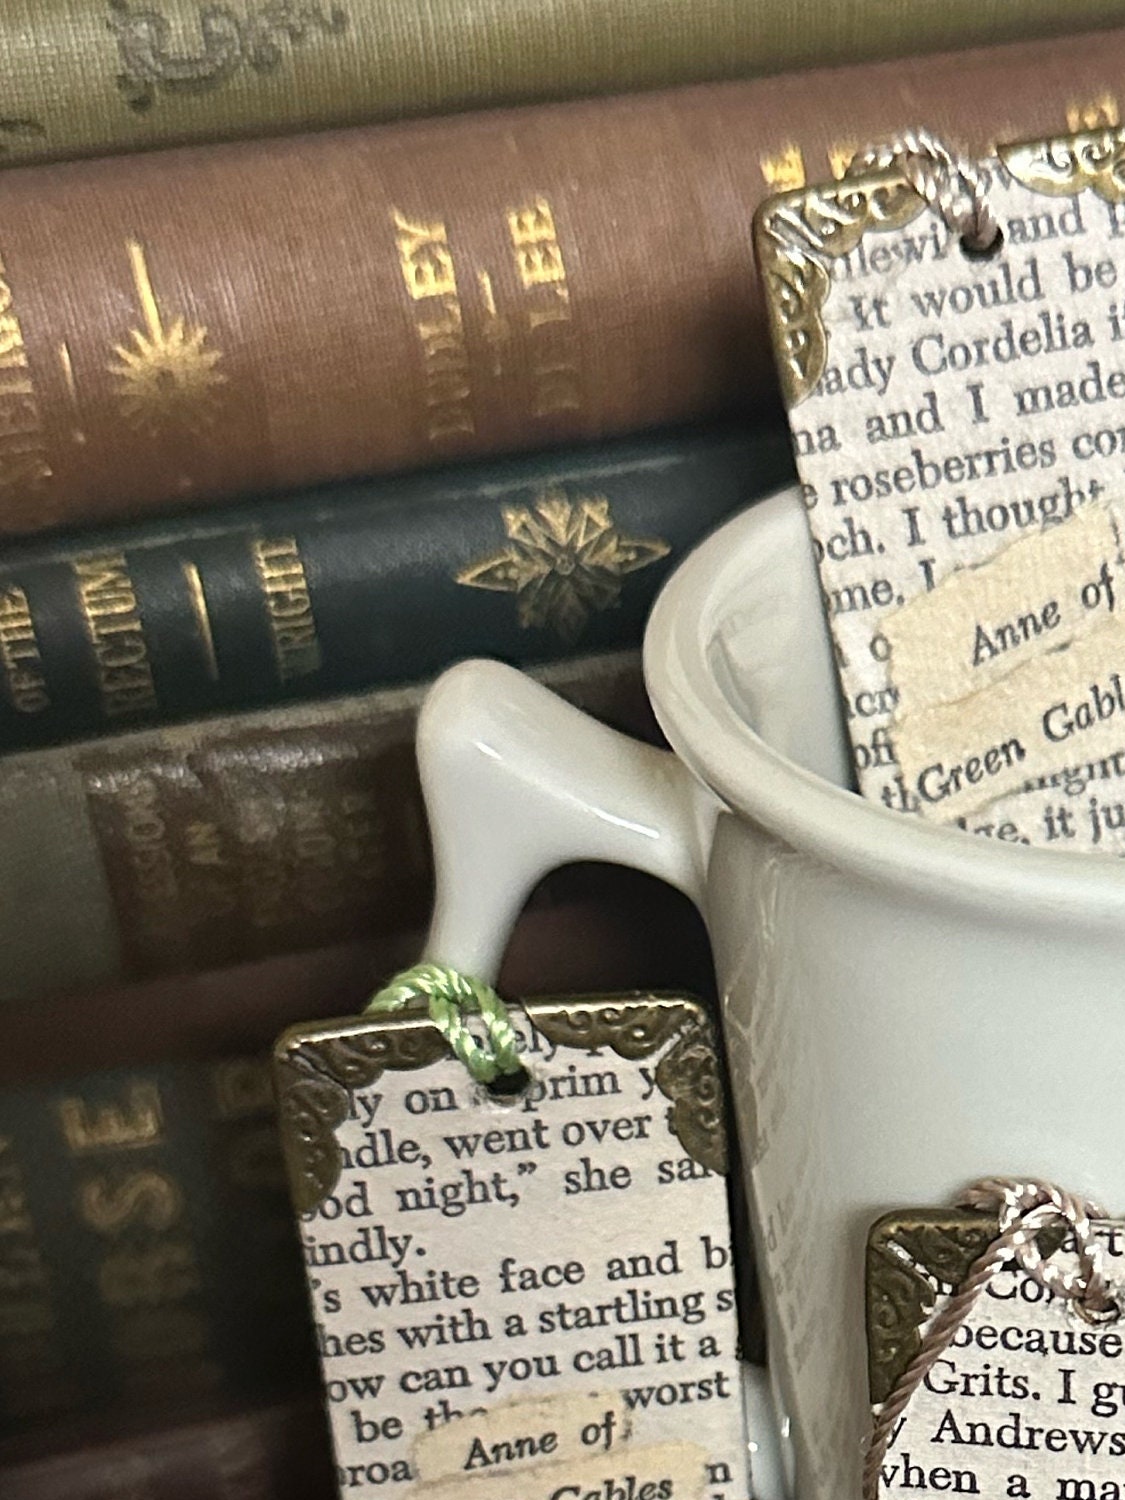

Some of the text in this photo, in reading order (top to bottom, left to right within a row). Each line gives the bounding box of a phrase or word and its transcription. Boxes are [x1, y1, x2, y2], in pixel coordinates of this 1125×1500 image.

[1010, 200, 1085, 244] and
[910, 250, 1117, 317] would be
[911, 311, 1095, 375] Cordelia
[866, 390, 945, 443] and
[830, 439, 1056, 506] roseberries
[972, 562, 1119, 667] Anne of
[918, 734, 1027, 804] Green
[1044, 793, 1076, 833] it
[404, 1086, 460, 1116] on
[442, 1114, 653, 1160] went over
[564, 1156, 632, 1196] she
[359, 1239, 683, 1308] white face and
[395, 1288, 706, 1350] with startling
[398, 1332, 645, 1394] can call
[621, 1370, 731, 1411] worst
[922, 1360, 1042, 1402] Grits.
[462, 1411, 617, 1471] Anne of
